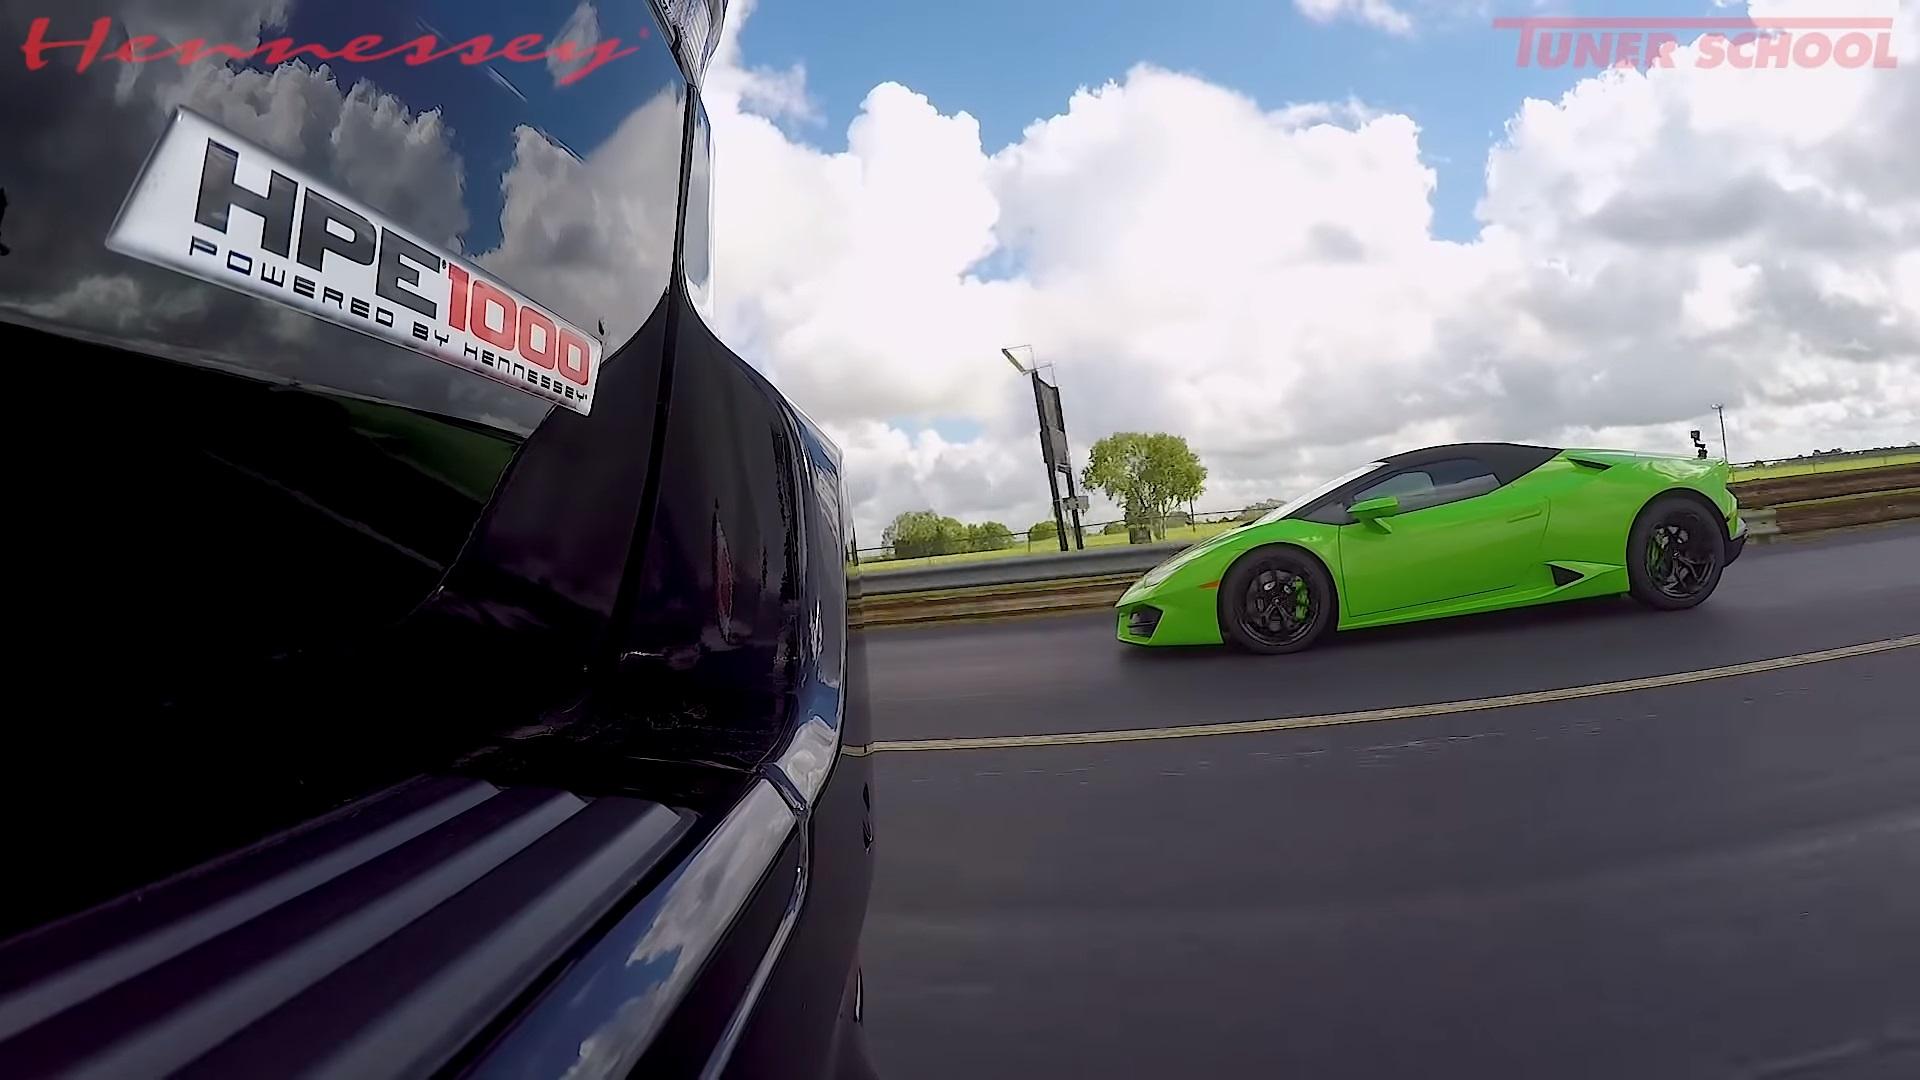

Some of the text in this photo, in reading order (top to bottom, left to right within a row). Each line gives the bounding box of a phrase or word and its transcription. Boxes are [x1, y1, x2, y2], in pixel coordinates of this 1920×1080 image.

[189, 235, 586, 402] POWERED BY HENNESSEY
[447, 261, 590, 391] 1000
